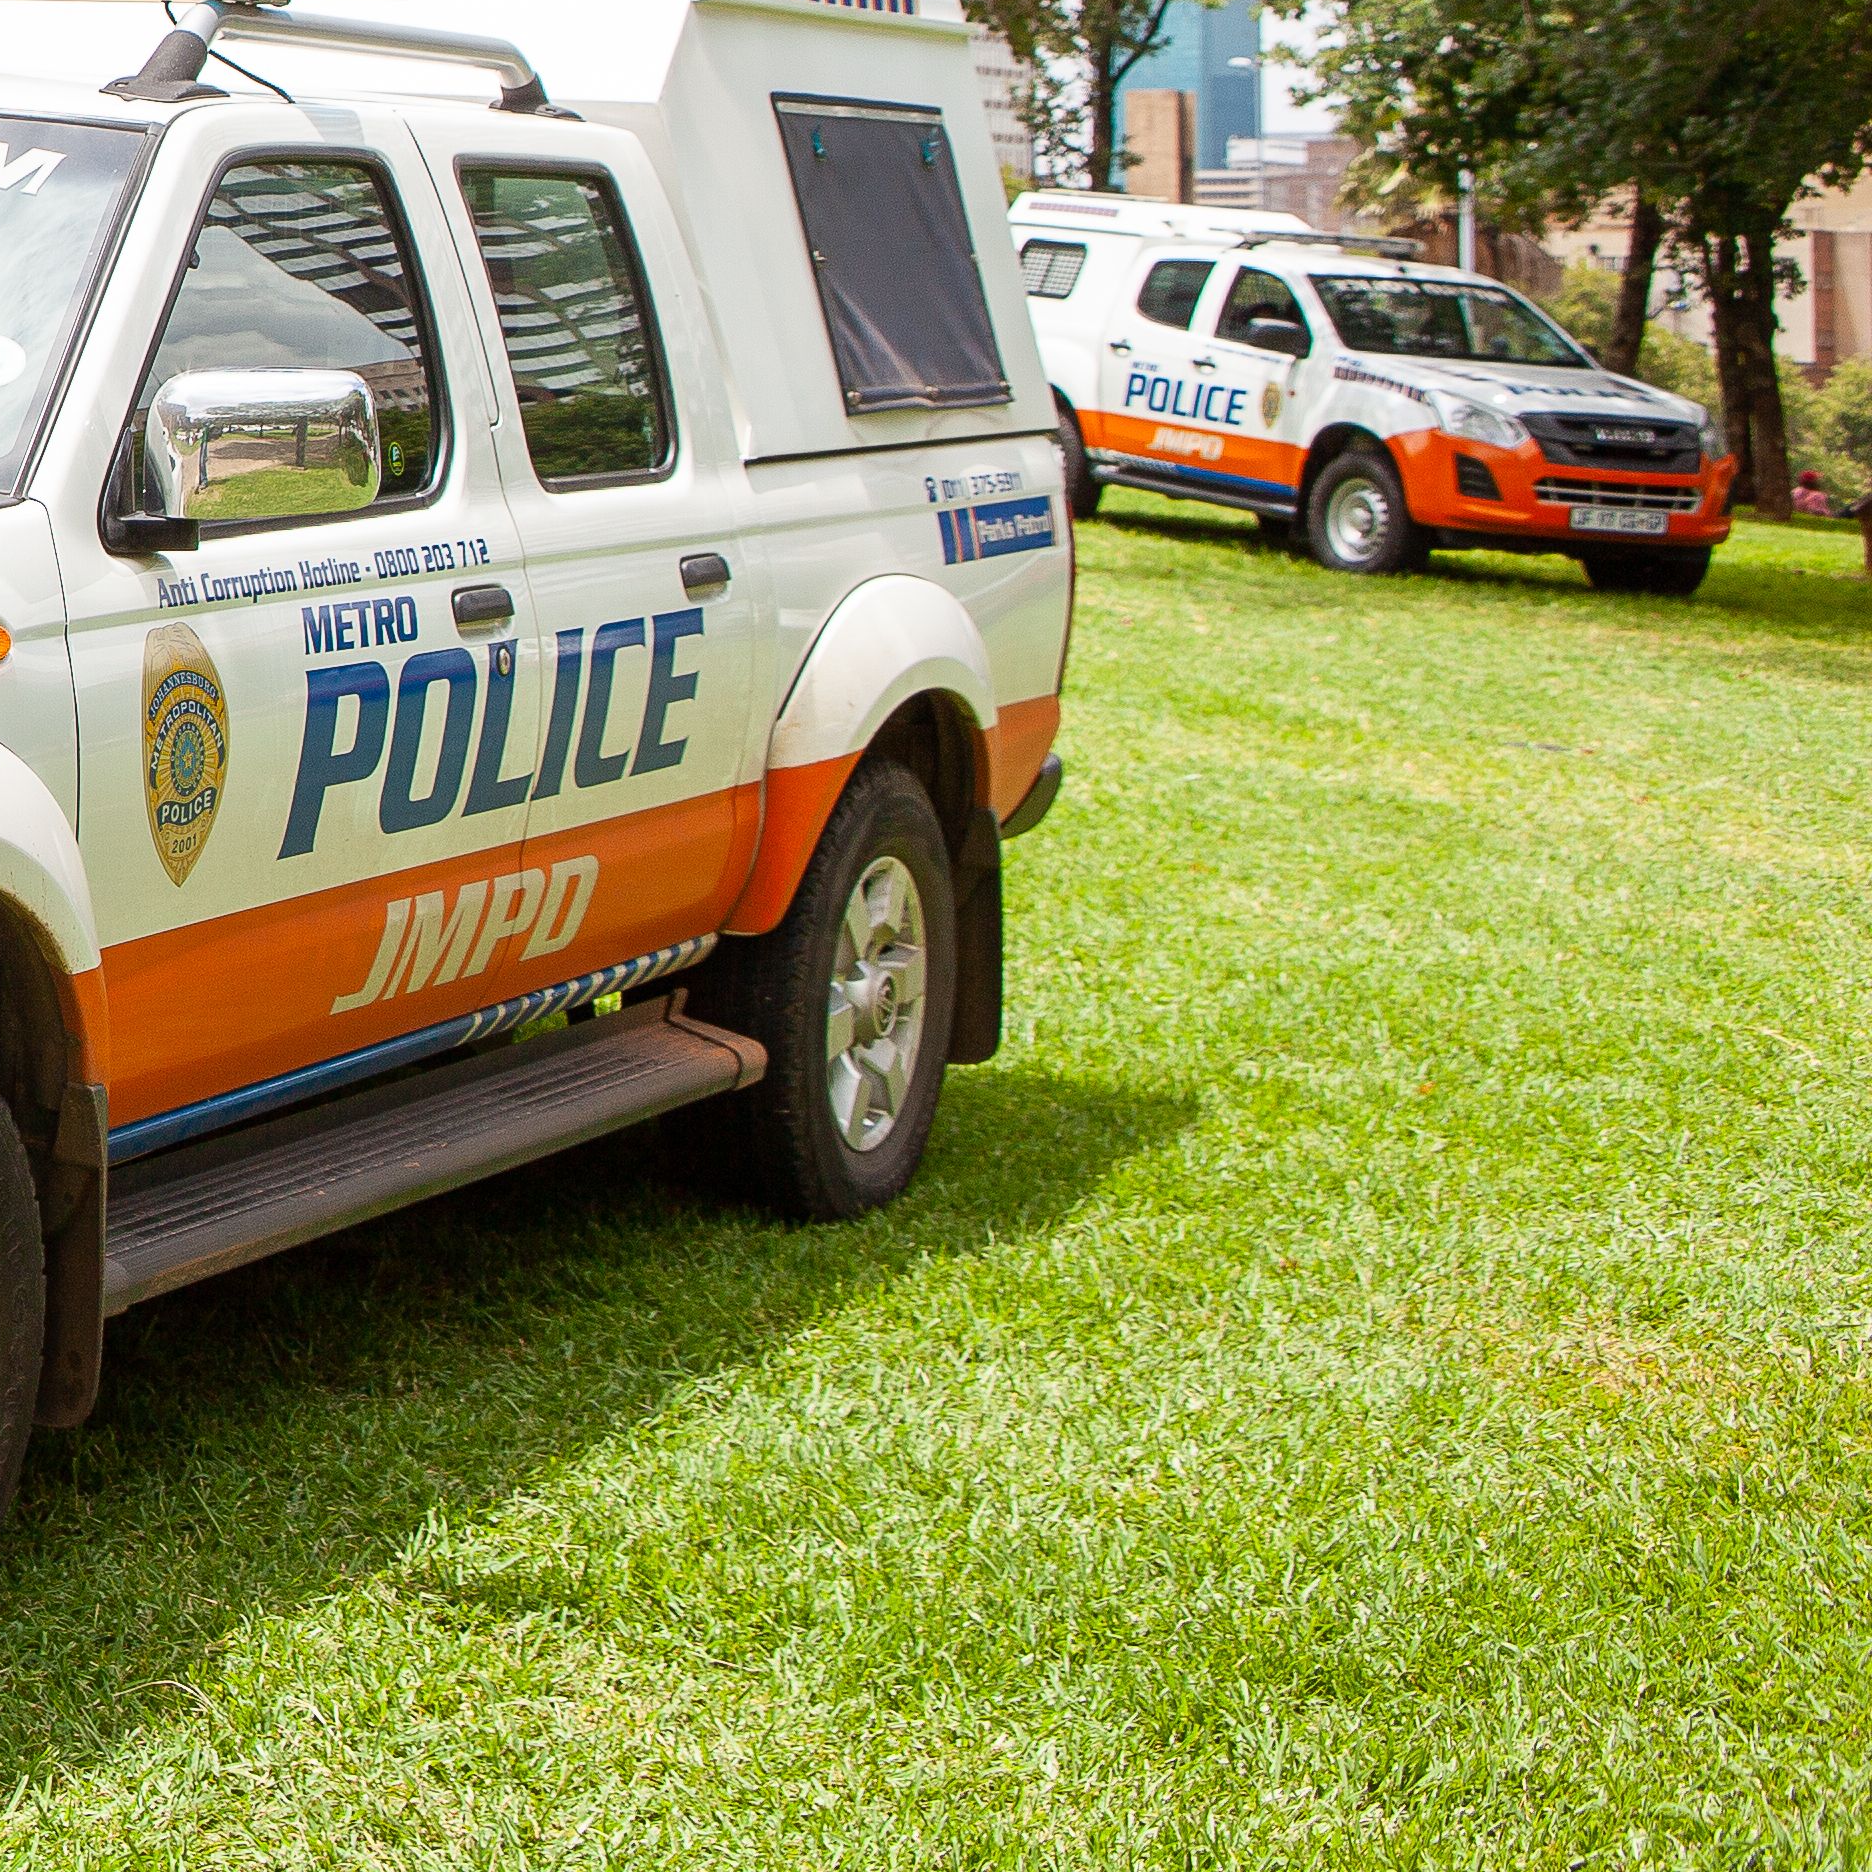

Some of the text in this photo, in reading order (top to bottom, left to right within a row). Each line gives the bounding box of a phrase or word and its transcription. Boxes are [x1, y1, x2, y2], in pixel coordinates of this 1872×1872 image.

[1125, 373, 1248, 426] POLICE
[157, 576, 198, 609] Anti
[201, 567, 298, 603] Corruption
[299, 558, 362, 590] Hotline
[373, 547, 420, 579] 0800
[421, 542, 456, 573] 203
[457, 538, 491, 568] 712
[301, 595, 419, 655] METRO
[149, 671, 218, 718] JOHANNESBURG
[151, 702, 224, 770] METROPOLITAN
[276, 607, 705, 861] POLICE
[161, 788, 213, 824] POLICE
[171, 834, 198, 854] 2001
[330, 854, 600, 1016] JMPD
